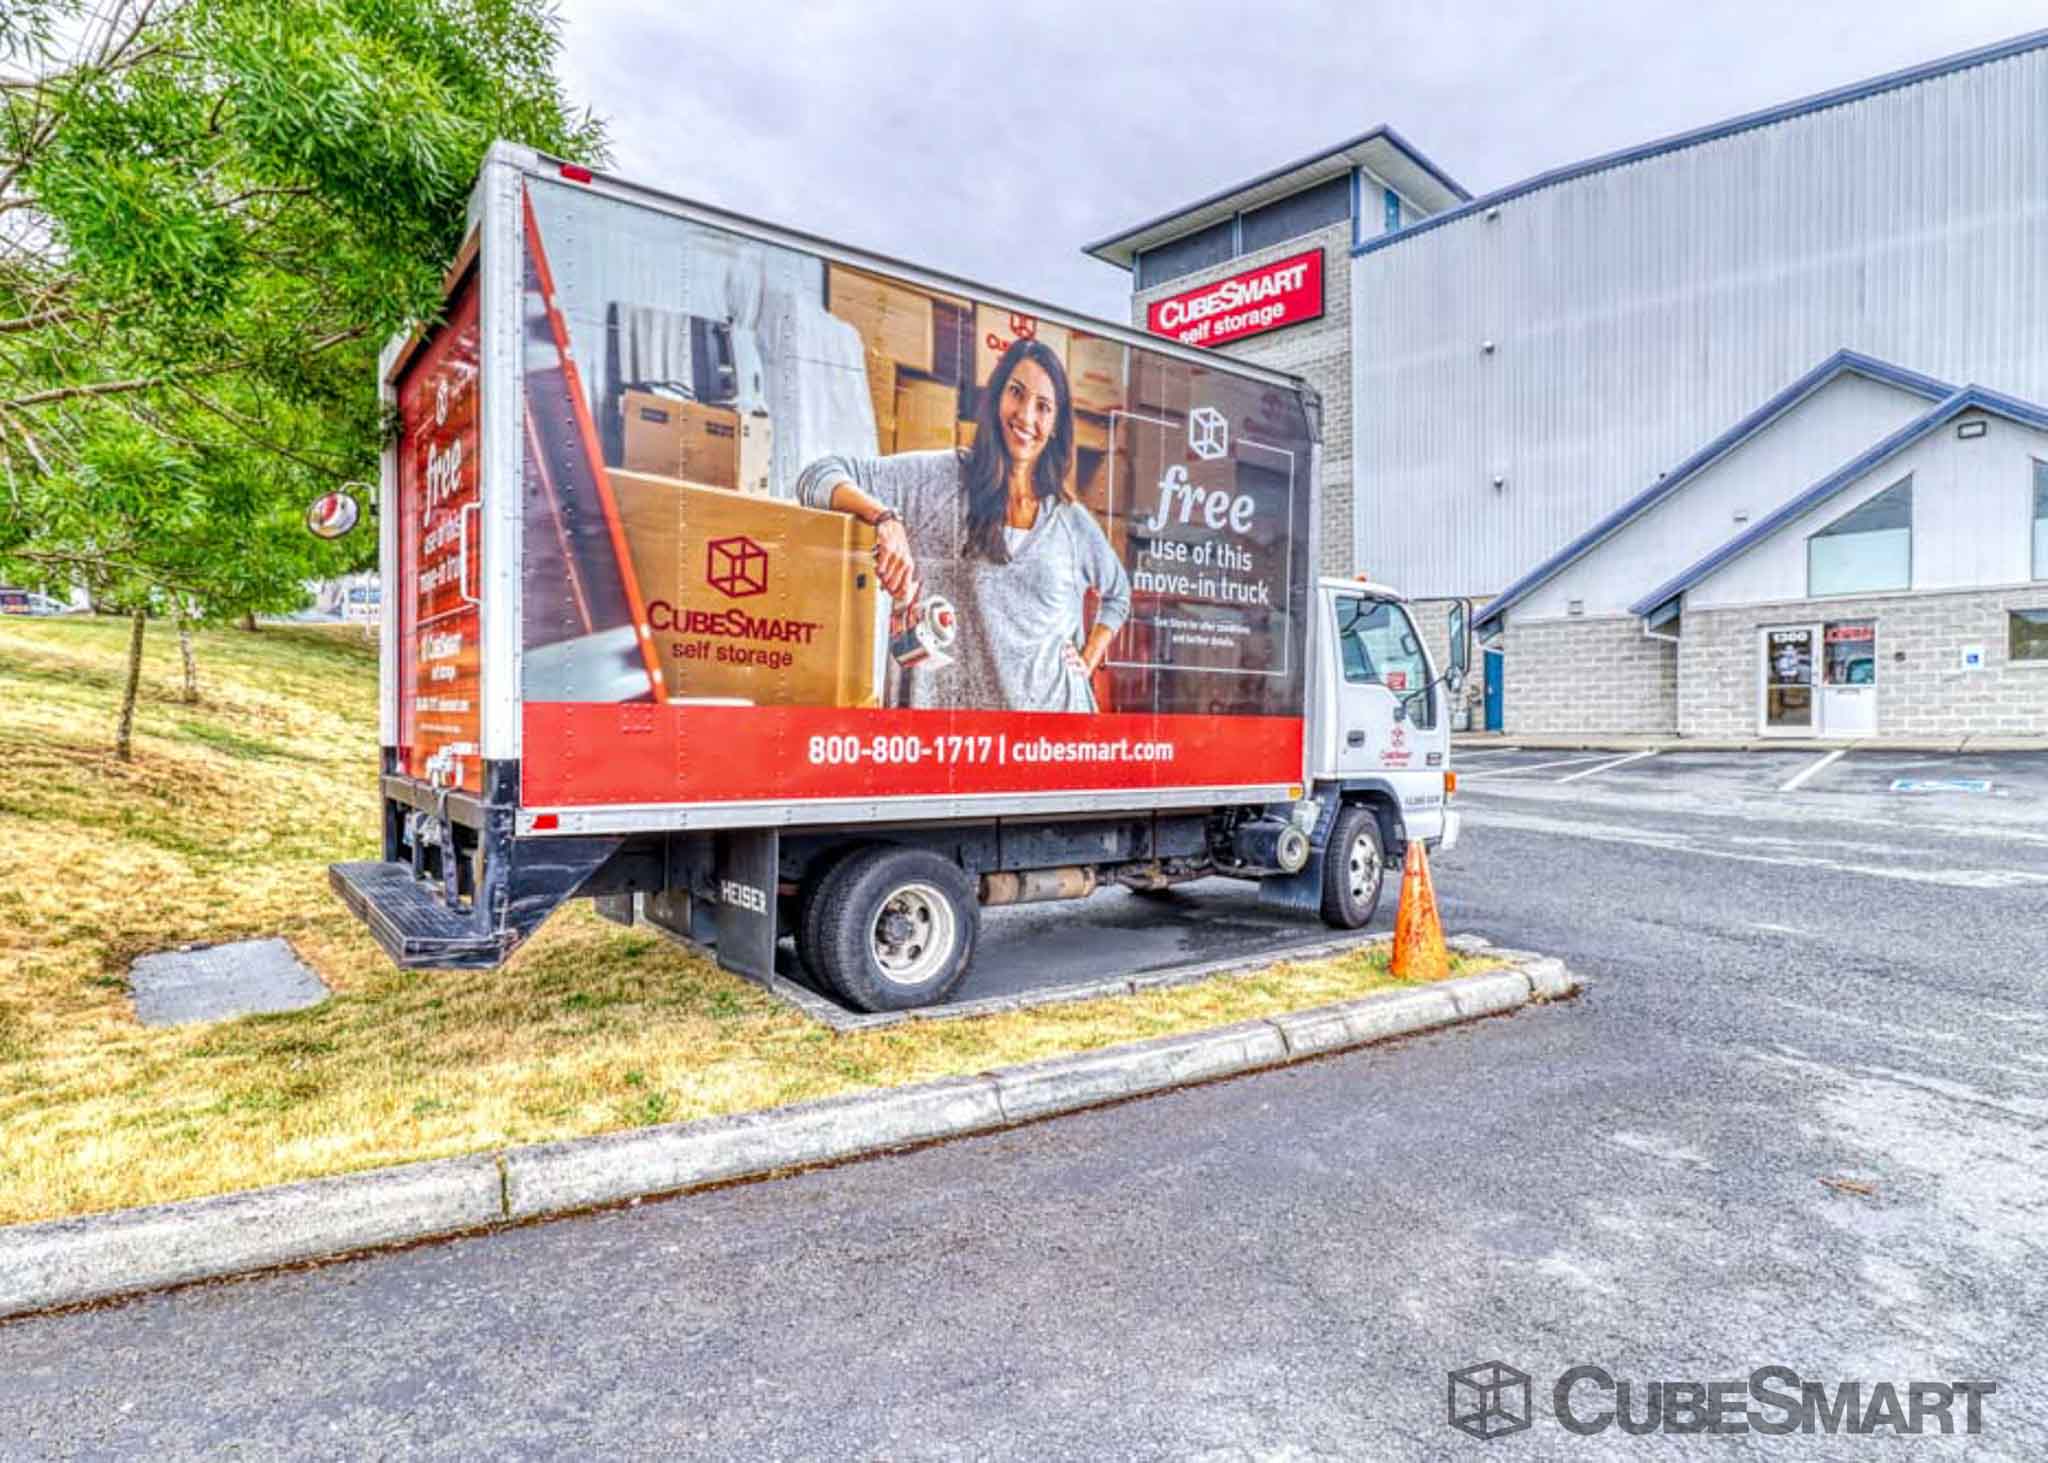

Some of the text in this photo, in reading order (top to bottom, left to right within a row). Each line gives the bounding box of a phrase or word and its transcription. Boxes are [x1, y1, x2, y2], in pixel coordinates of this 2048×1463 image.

[1213, 302, 1286, 335] storage
[1148, 464, 1256, 533] free
[1150, 538, 1253, 570] use of this
[1133, 568, 1269, 605] move-in truck
[672, 641, 793, 669] self storage
[808, 736, 1174, 764] 800-800-1717 cubesmart.com
